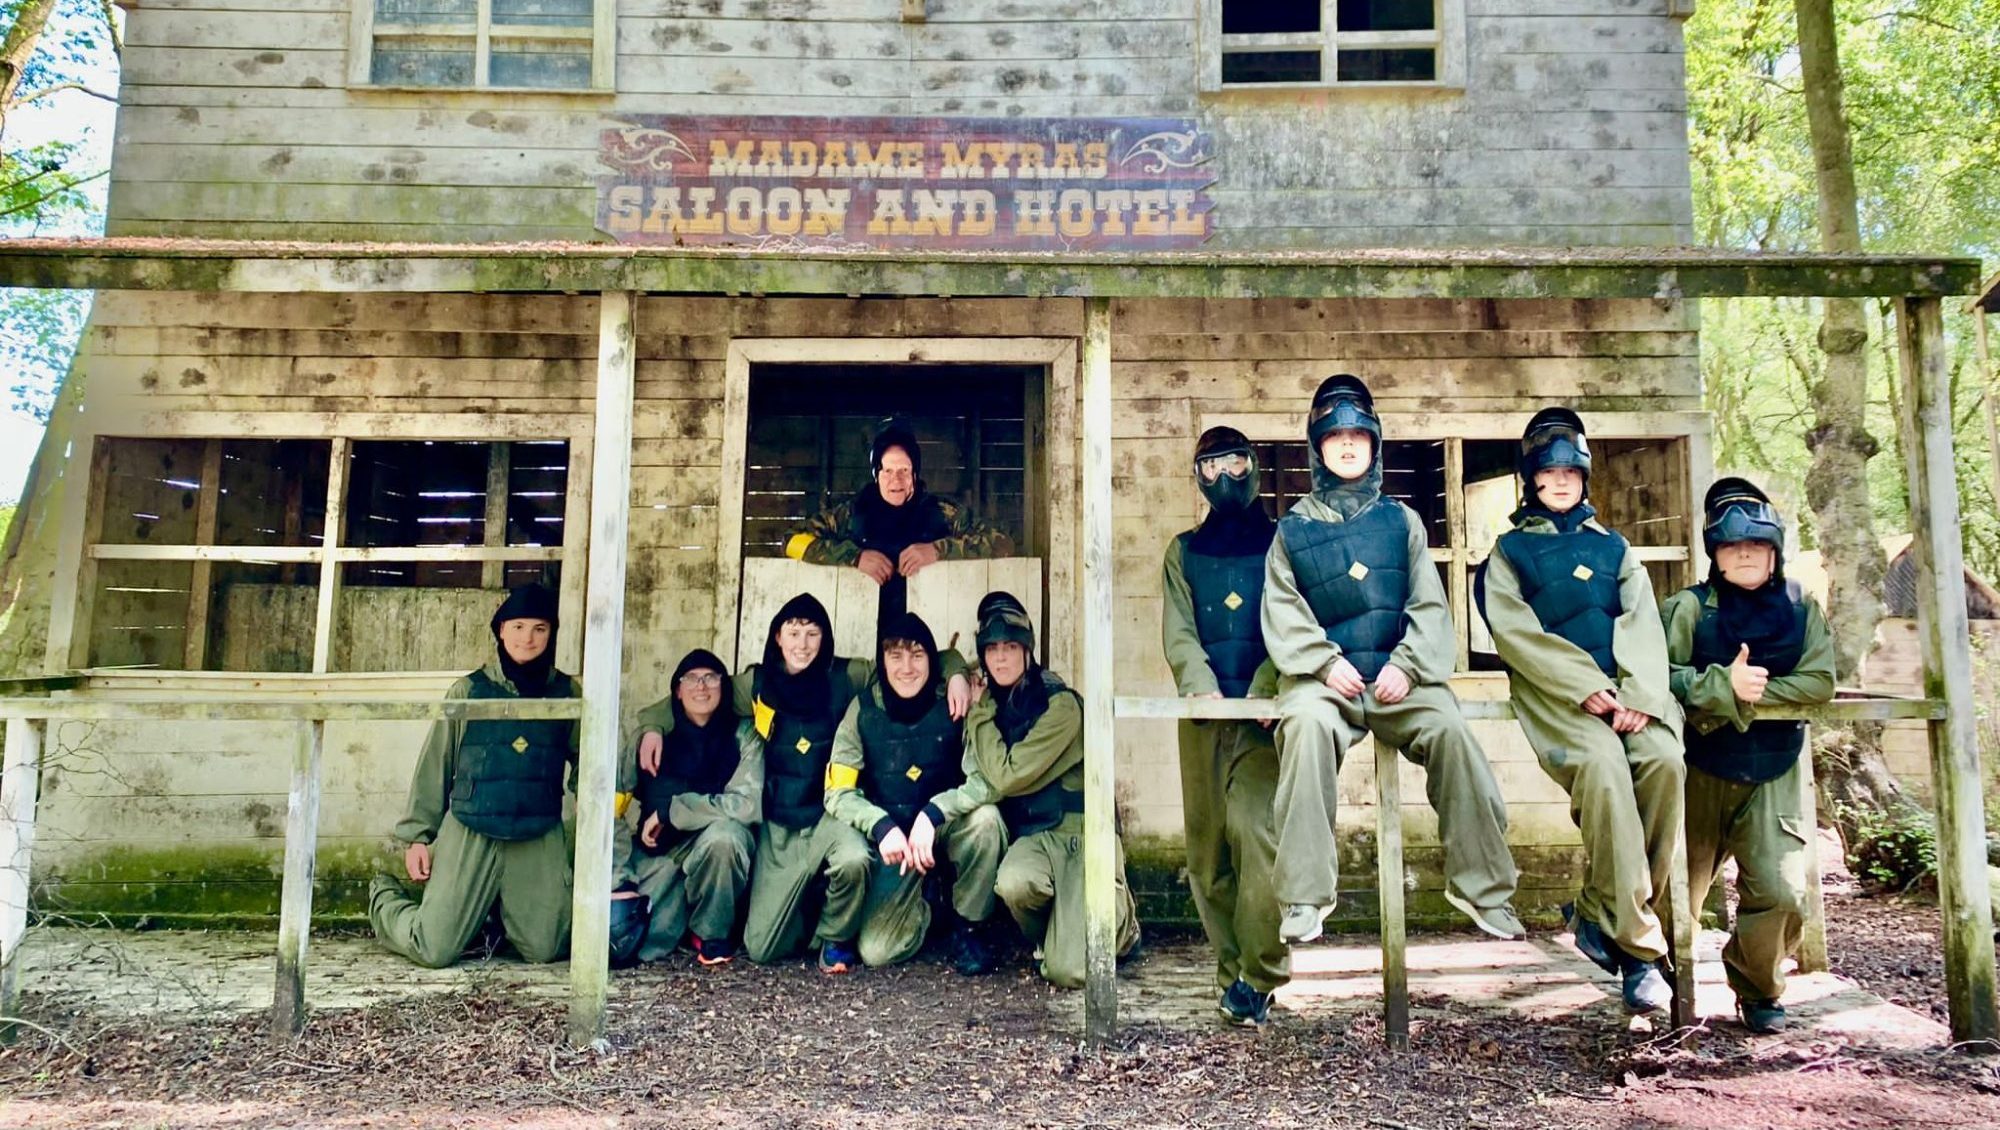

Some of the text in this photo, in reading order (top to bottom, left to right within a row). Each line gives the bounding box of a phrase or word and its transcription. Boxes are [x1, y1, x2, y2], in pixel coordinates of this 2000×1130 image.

[708, 139, 1108, 179] MADAME MYRAS
[607, 185, 1206, 237] SALOON AND HOTEL
